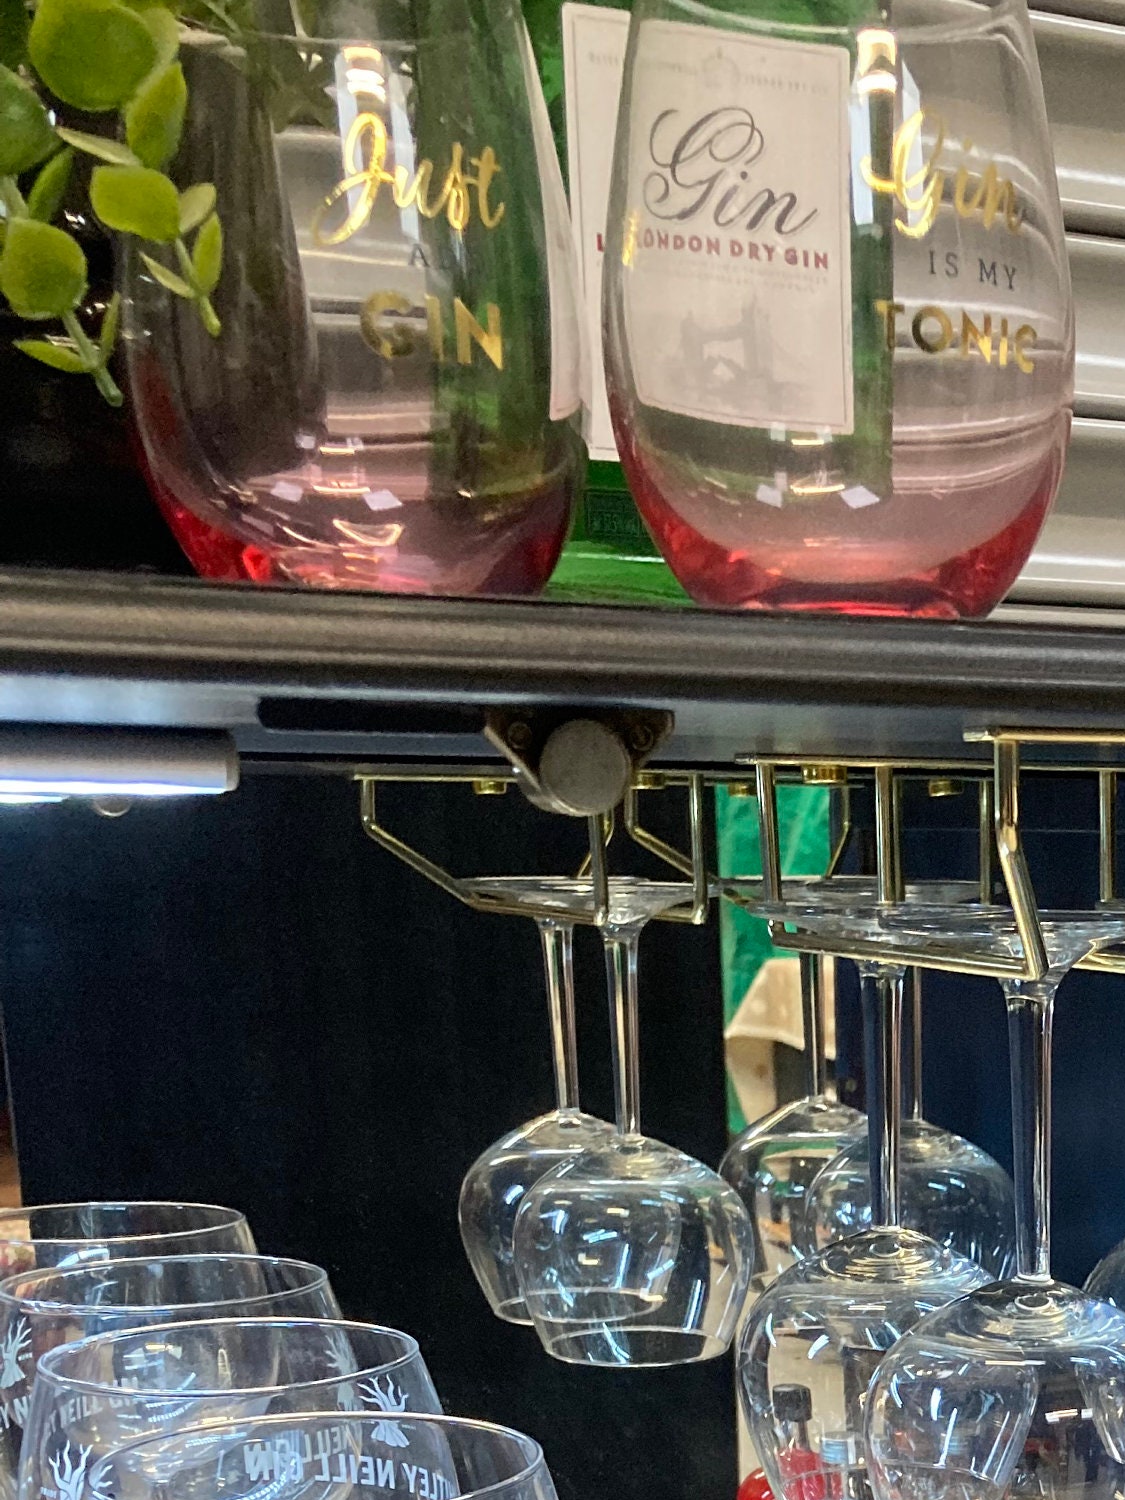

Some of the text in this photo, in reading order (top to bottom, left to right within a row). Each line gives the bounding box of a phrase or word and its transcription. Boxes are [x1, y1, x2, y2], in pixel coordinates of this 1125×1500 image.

[311, 112, 505, 246] Just
[644, 105, 819, 236] Gin
[859, 108, 1026, 239] Gin
[597, 225, 830, 271] LONDON DRY GIN
[927, 249, 1018, 291] IS MY
[360, 289, 505, 371] GIN
[876, 299, 1040, 374] TONIC
